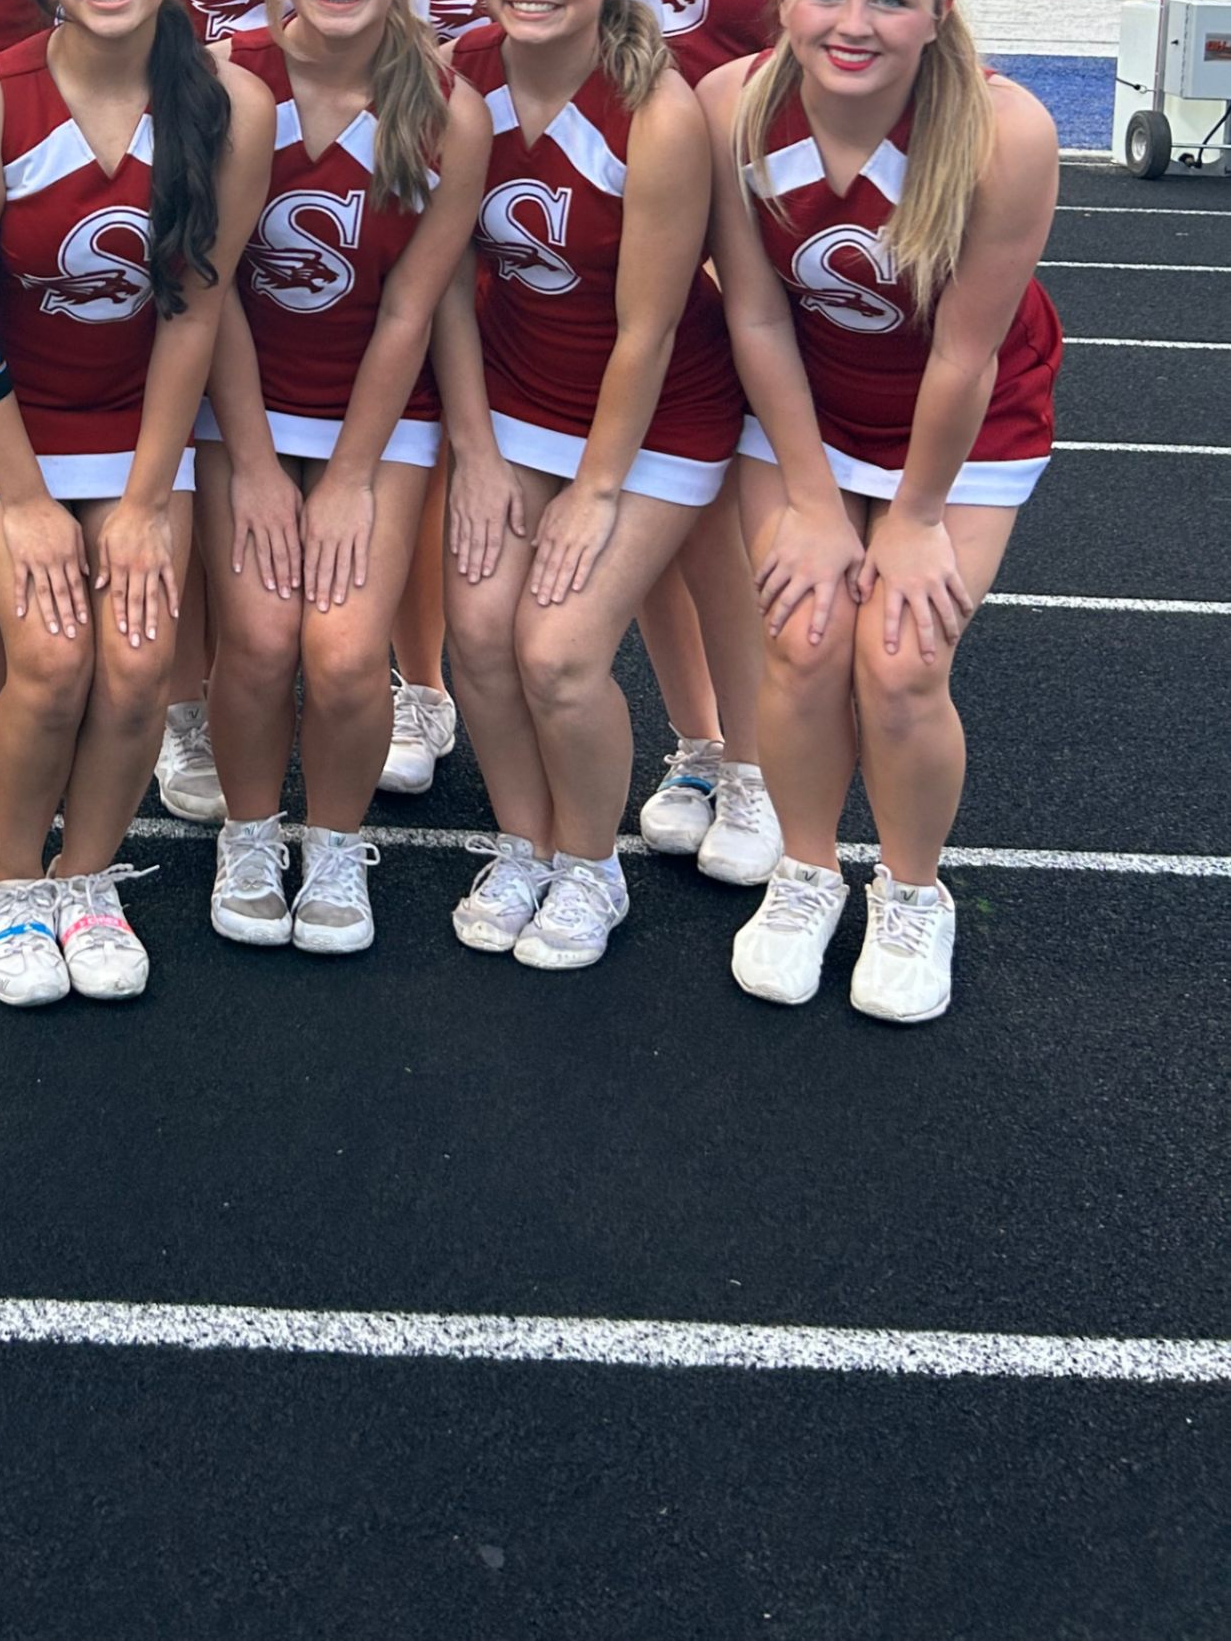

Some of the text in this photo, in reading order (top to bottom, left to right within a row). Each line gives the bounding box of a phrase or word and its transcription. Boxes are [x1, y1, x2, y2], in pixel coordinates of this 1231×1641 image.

[39, 205, 154, 325] S
[250, 188, 367, 314] S
[479, 178, 582, 296] S
[791, 224, 905, 334] S
